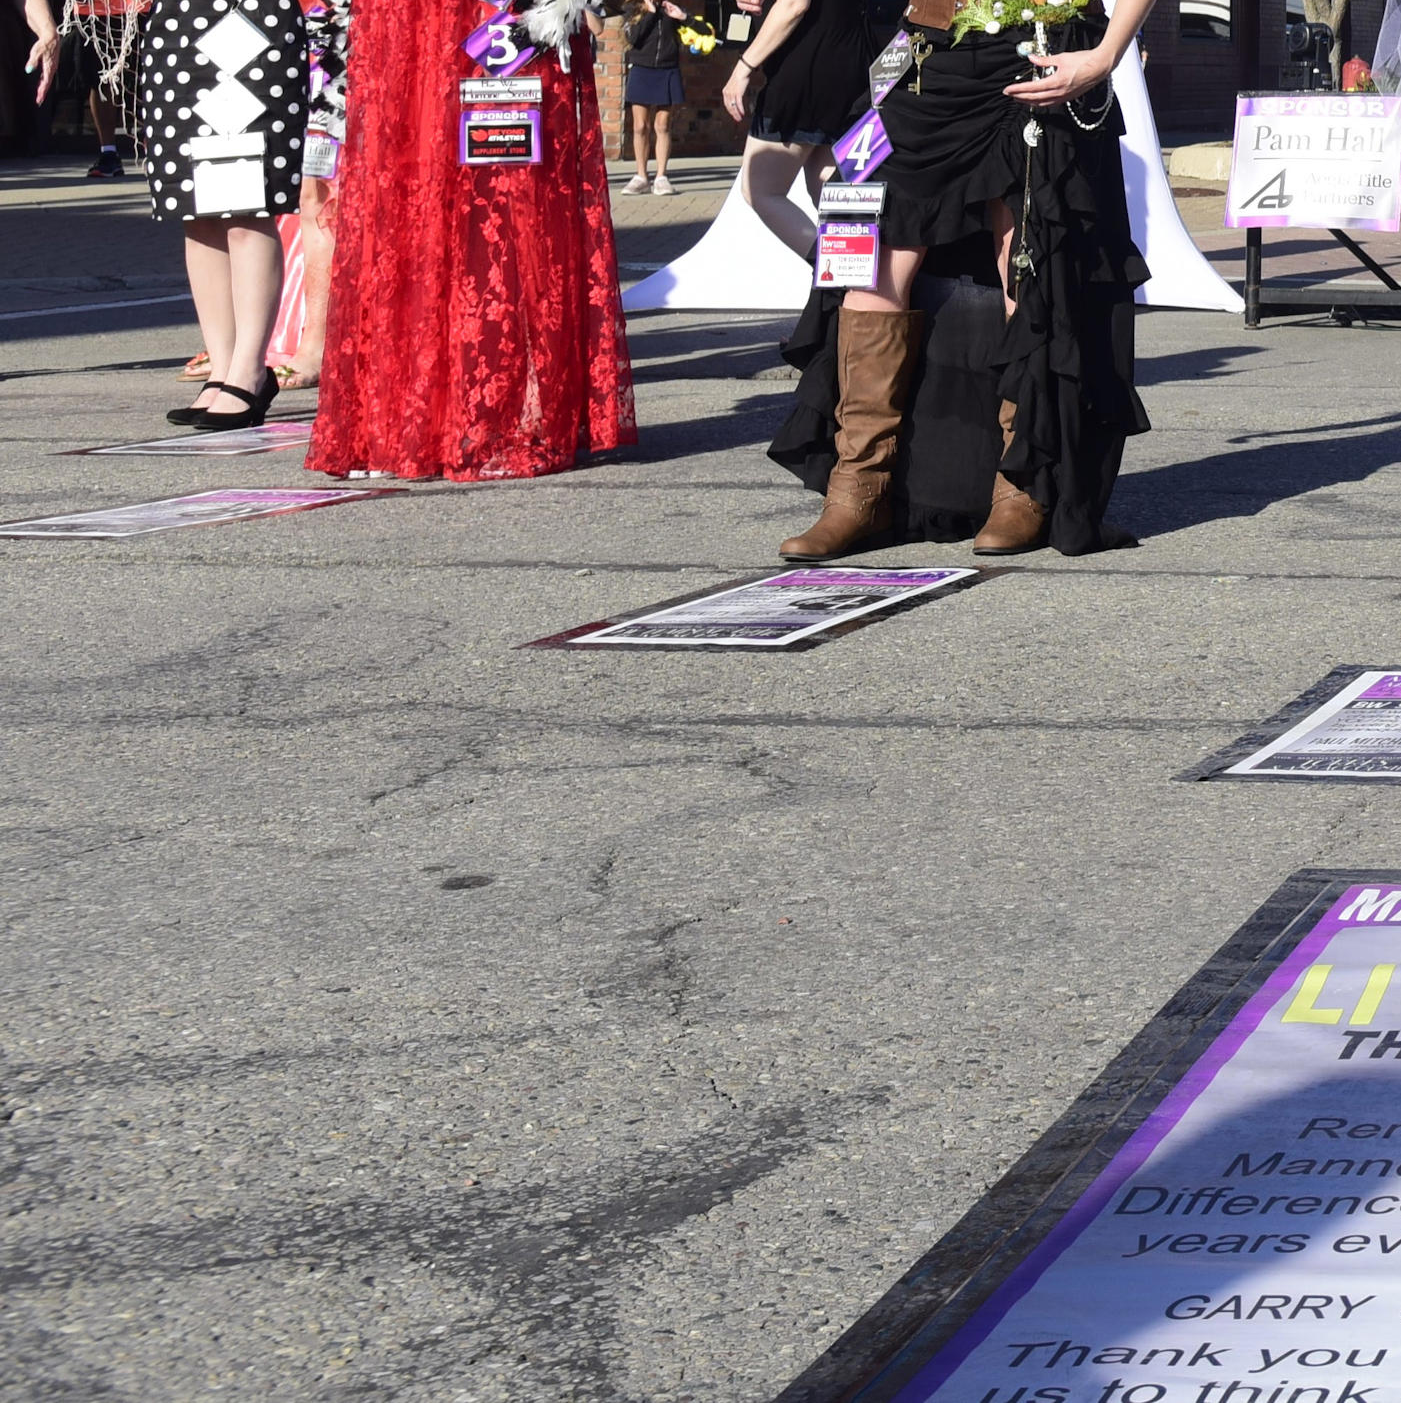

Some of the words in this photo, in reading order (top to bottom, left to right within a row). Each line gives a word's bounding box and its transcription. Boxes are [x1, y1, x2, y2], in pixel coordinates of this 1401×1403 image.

[487, 24, 519, 66] 3
[1260, 99, 1384, 116] SPONSOR
[846, 123, 875, 170] 4
[1252, 126, 1311, 151] Pam
[1325, 127, 1385, 153] Hall
[826, 226, 870, 235] SPONSOR
[1353, 700, 1392, 709] BW
[1308, 737, 1350, 745] PAUL
[1122, 1232, 1310, 1257] years
[1165, 1294, 1376, 1321] GARRY
[1006, 1341, 1232, 1369] Thank
[1248, 1349, 1400, 1374] you
[980, 1386, 1071, 1403] us
[1102, 1378, 1168, 1403] to
[1198, 1379, 1389, 1403] think
